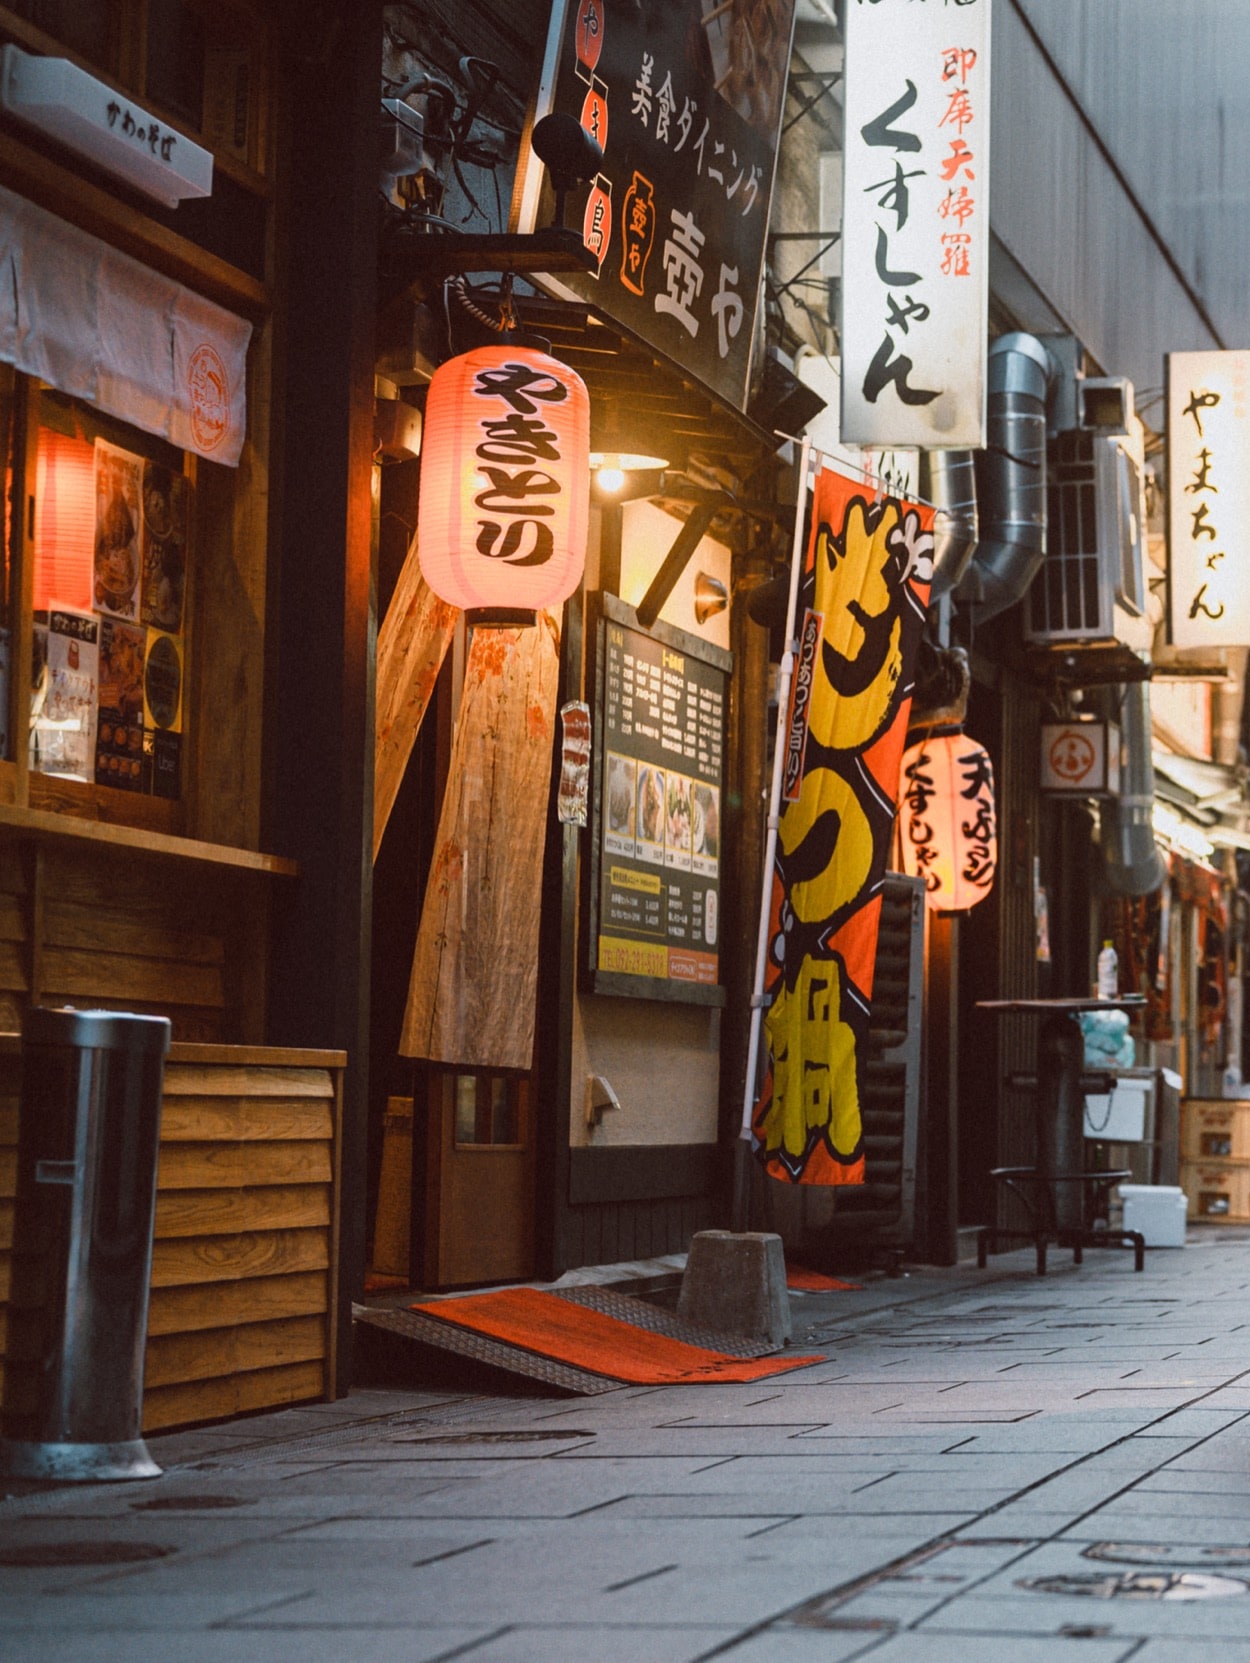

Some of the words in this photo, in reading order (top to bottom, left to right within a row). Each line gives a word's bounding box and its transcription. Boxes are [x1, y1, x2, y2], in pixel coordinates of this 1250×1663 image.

[860, 79, 943, 405] くすしゃん
[474, 364, 568, 566] やきとり
[1183, 389, 1225, 619] やまちゃん
